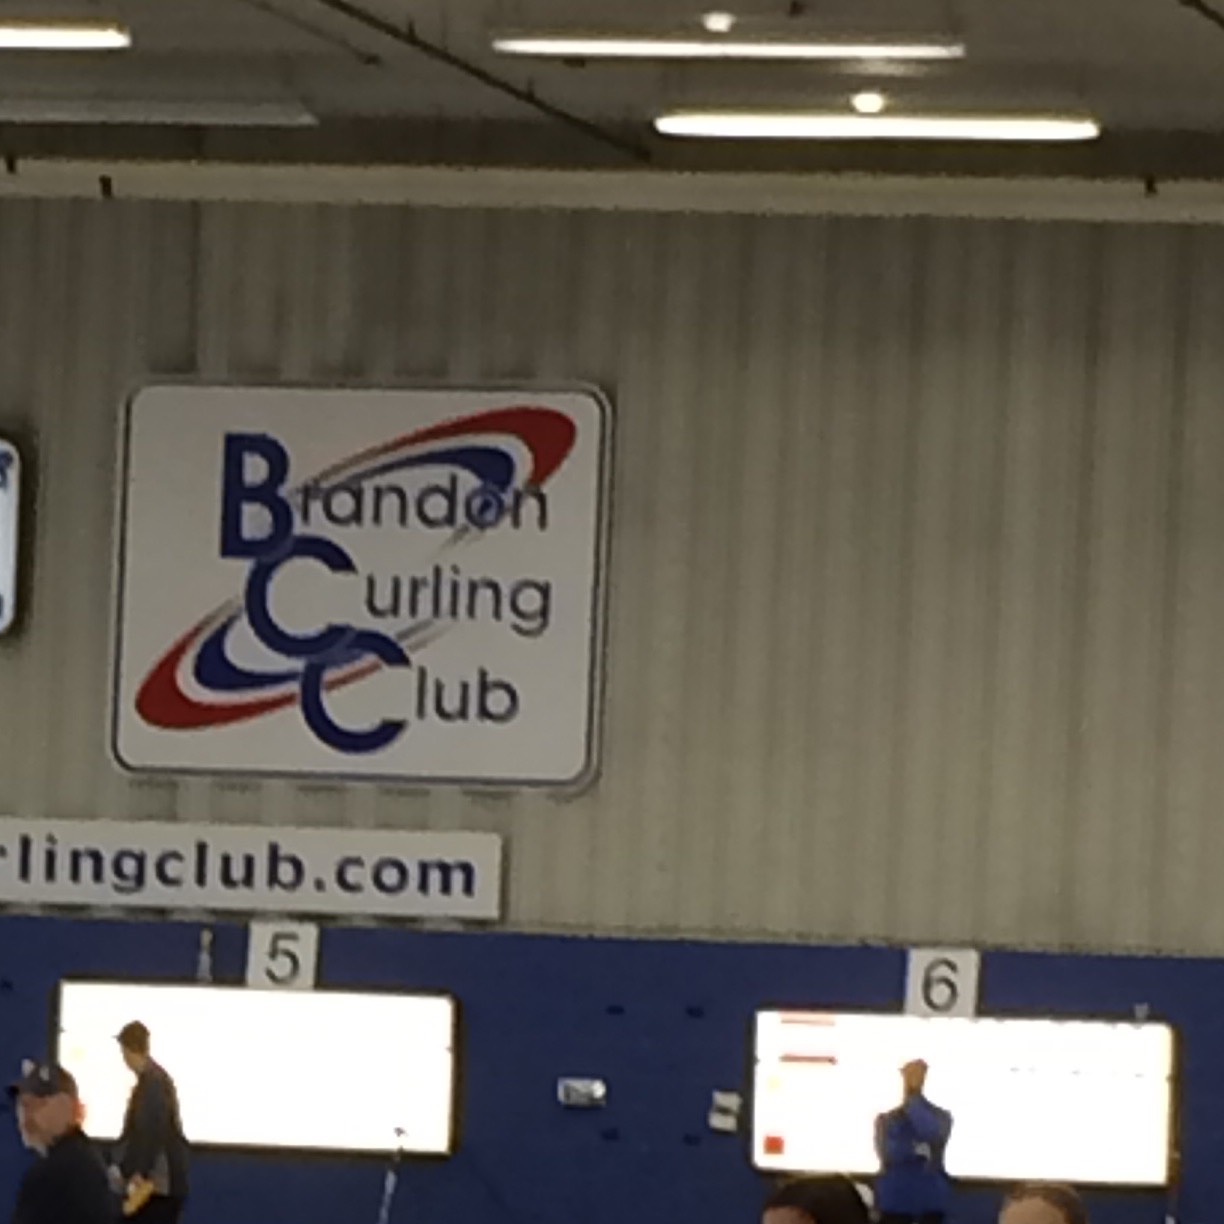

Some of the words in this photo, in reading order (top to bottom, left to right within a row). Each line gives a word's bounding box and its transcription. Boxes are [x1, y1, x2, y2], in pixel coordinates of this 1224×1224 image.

[220, 433, 549, 559] Brandon
[245, 534, 552, 657] Curling
[300, 627, 519, 754] Club
[264, 932, 302, 985] 5
[921, 957, 959, 1012] 6
